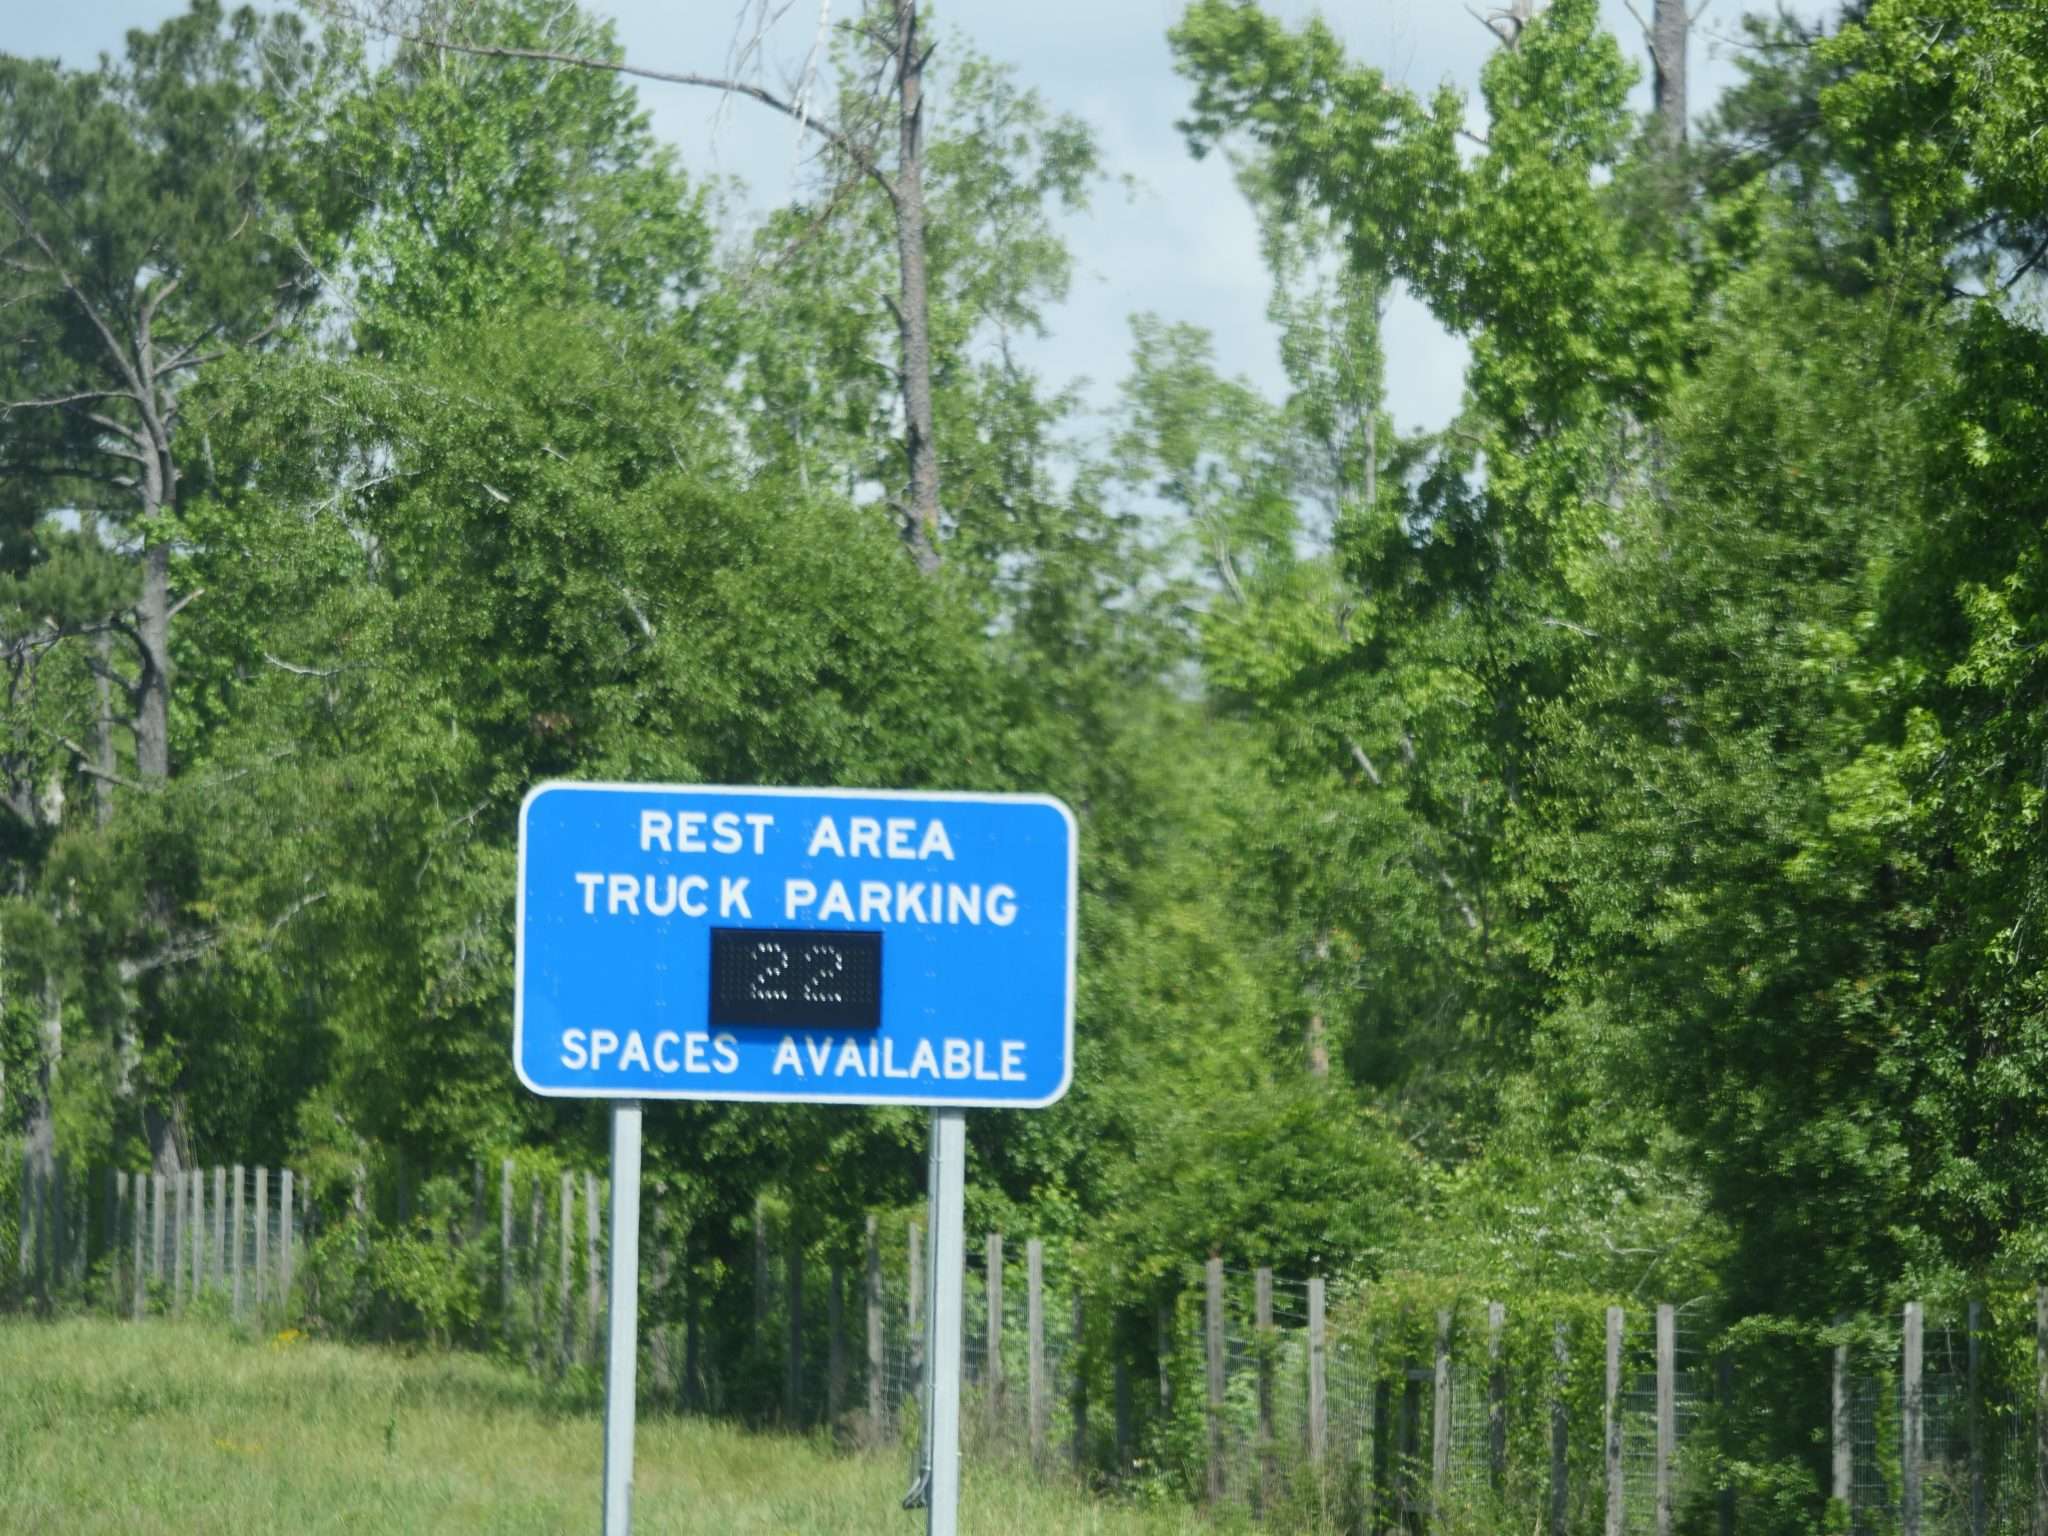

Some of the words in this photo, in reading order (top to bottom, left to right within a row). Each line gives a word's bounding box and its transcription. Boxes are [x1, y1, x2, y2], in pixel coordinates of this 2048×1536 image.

[641, 810, 774, 855] REST
[808, 816, 955, 860] AREA
[575, 873, 752, 918] TRUCK
[785, 879, 1018, 926] PARKING
[751, 943, 842, 1002] 22
[561, 1029, 739, 1074] SPACES
[772, 1036, 1027, 1081] AVAILABLE
